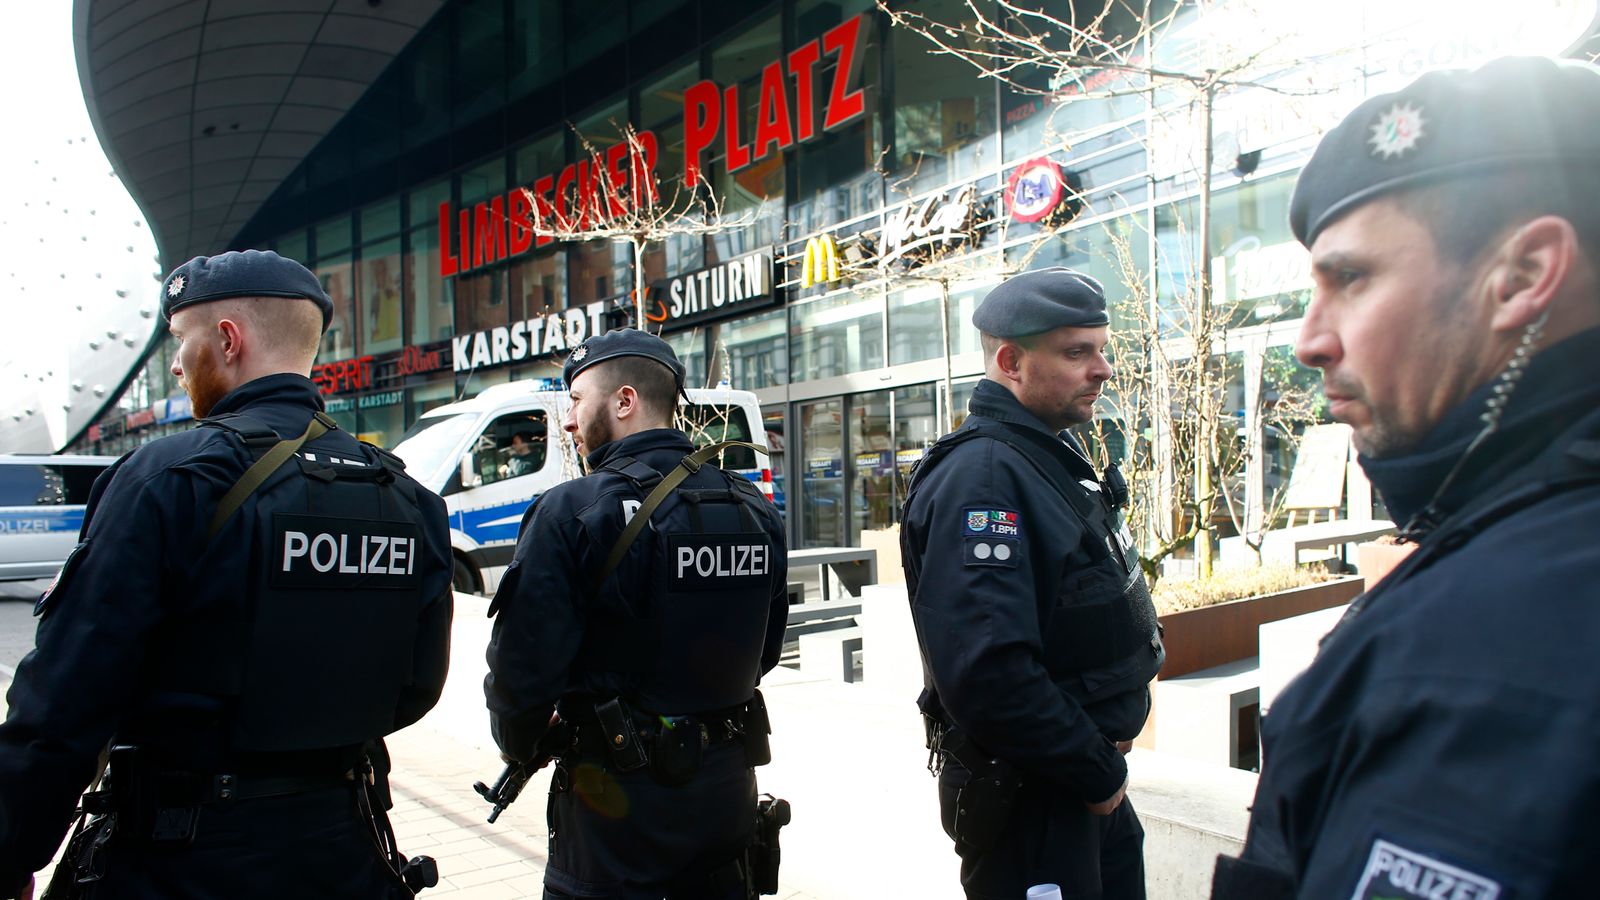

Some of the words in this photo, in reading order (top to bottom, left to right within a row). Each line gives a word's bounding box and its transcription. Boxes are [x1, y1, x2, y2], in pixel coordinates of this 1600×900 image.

[438, 130, 660, 278] LIMBECKER
[683, 15, 866, 188] PLATZ
[669, 253, 763, 318] SATURN
[452, 301, 606, 371] KARSTADT
[312, 355, 375, 395] ESPRIT
[359, 391, 403, 409] KARSTADT
[991, 511, 1017, 522] NRW
[282, 531, 416, 576] POLIZEI
[677, 544, 769, 578] POLIZEI
